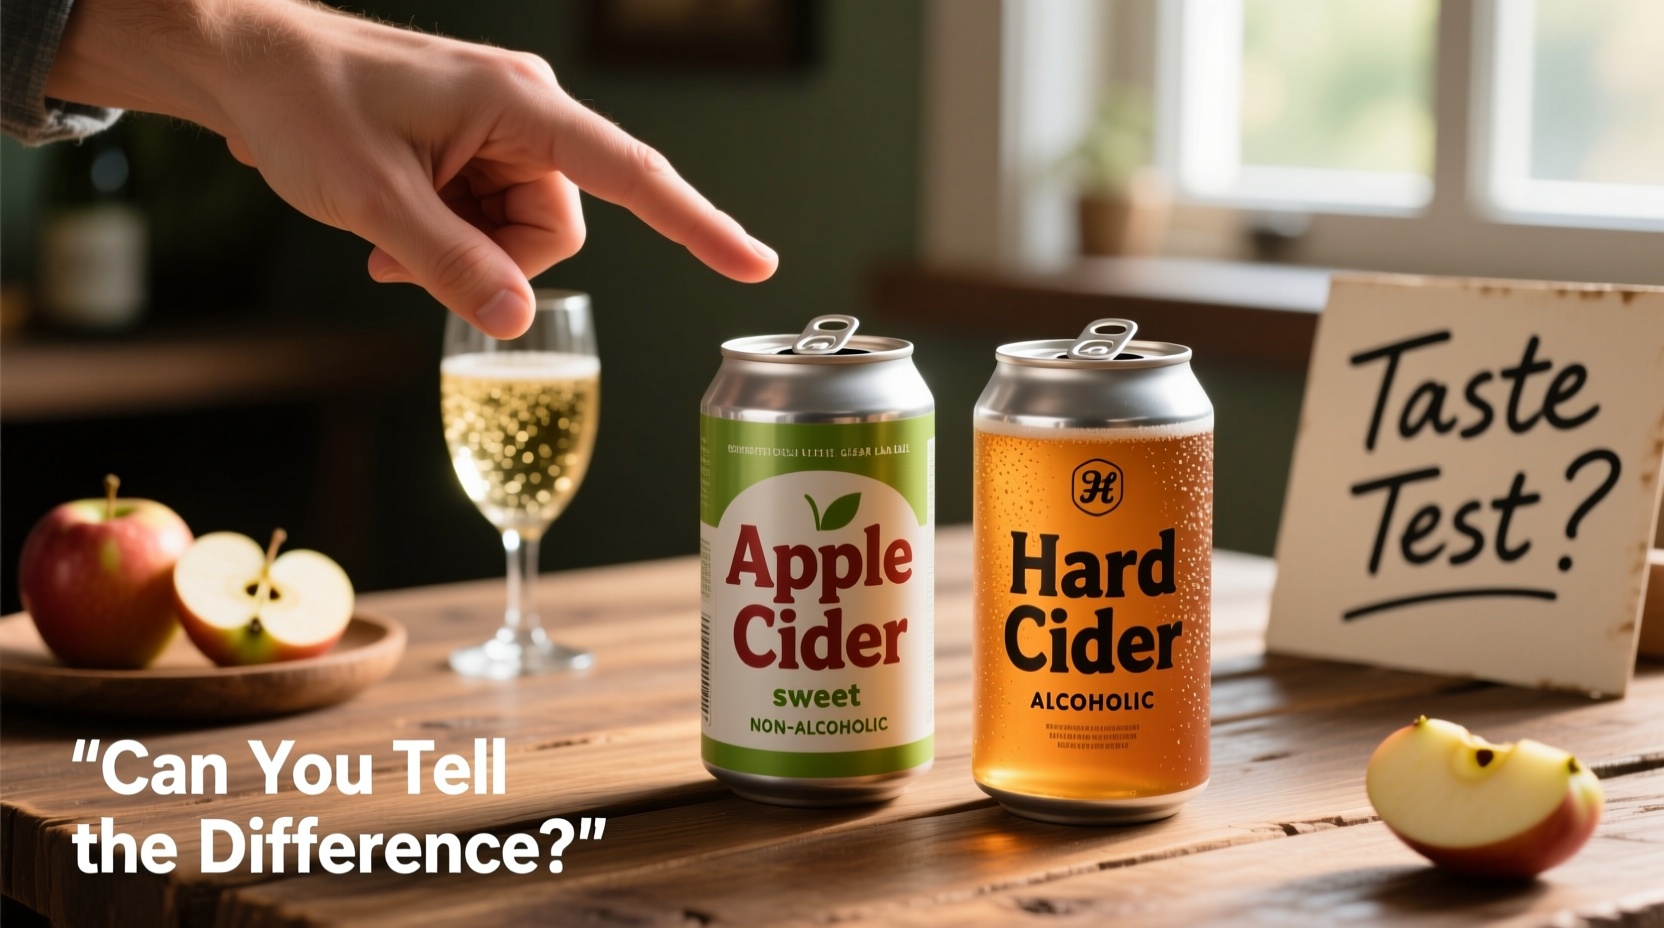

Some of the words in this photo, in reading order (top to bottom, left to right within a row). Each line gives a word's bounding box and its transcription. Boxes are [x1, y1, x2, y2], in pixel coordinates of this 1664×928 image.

[1348, 329, 1601, 453] Taste
[725, 522, 913, 604] Apple
[1010, 527, 1177, 599] Hard
[733, 603, 909, 671] Cider
[1004, 604, 1183, 675] Cider
[750, 716, 889, 736] NON-ALCOHOLIC
[772, 683, 862, 709] sweet
[1030, 691, 1155, 712] ALCOHOLIC
